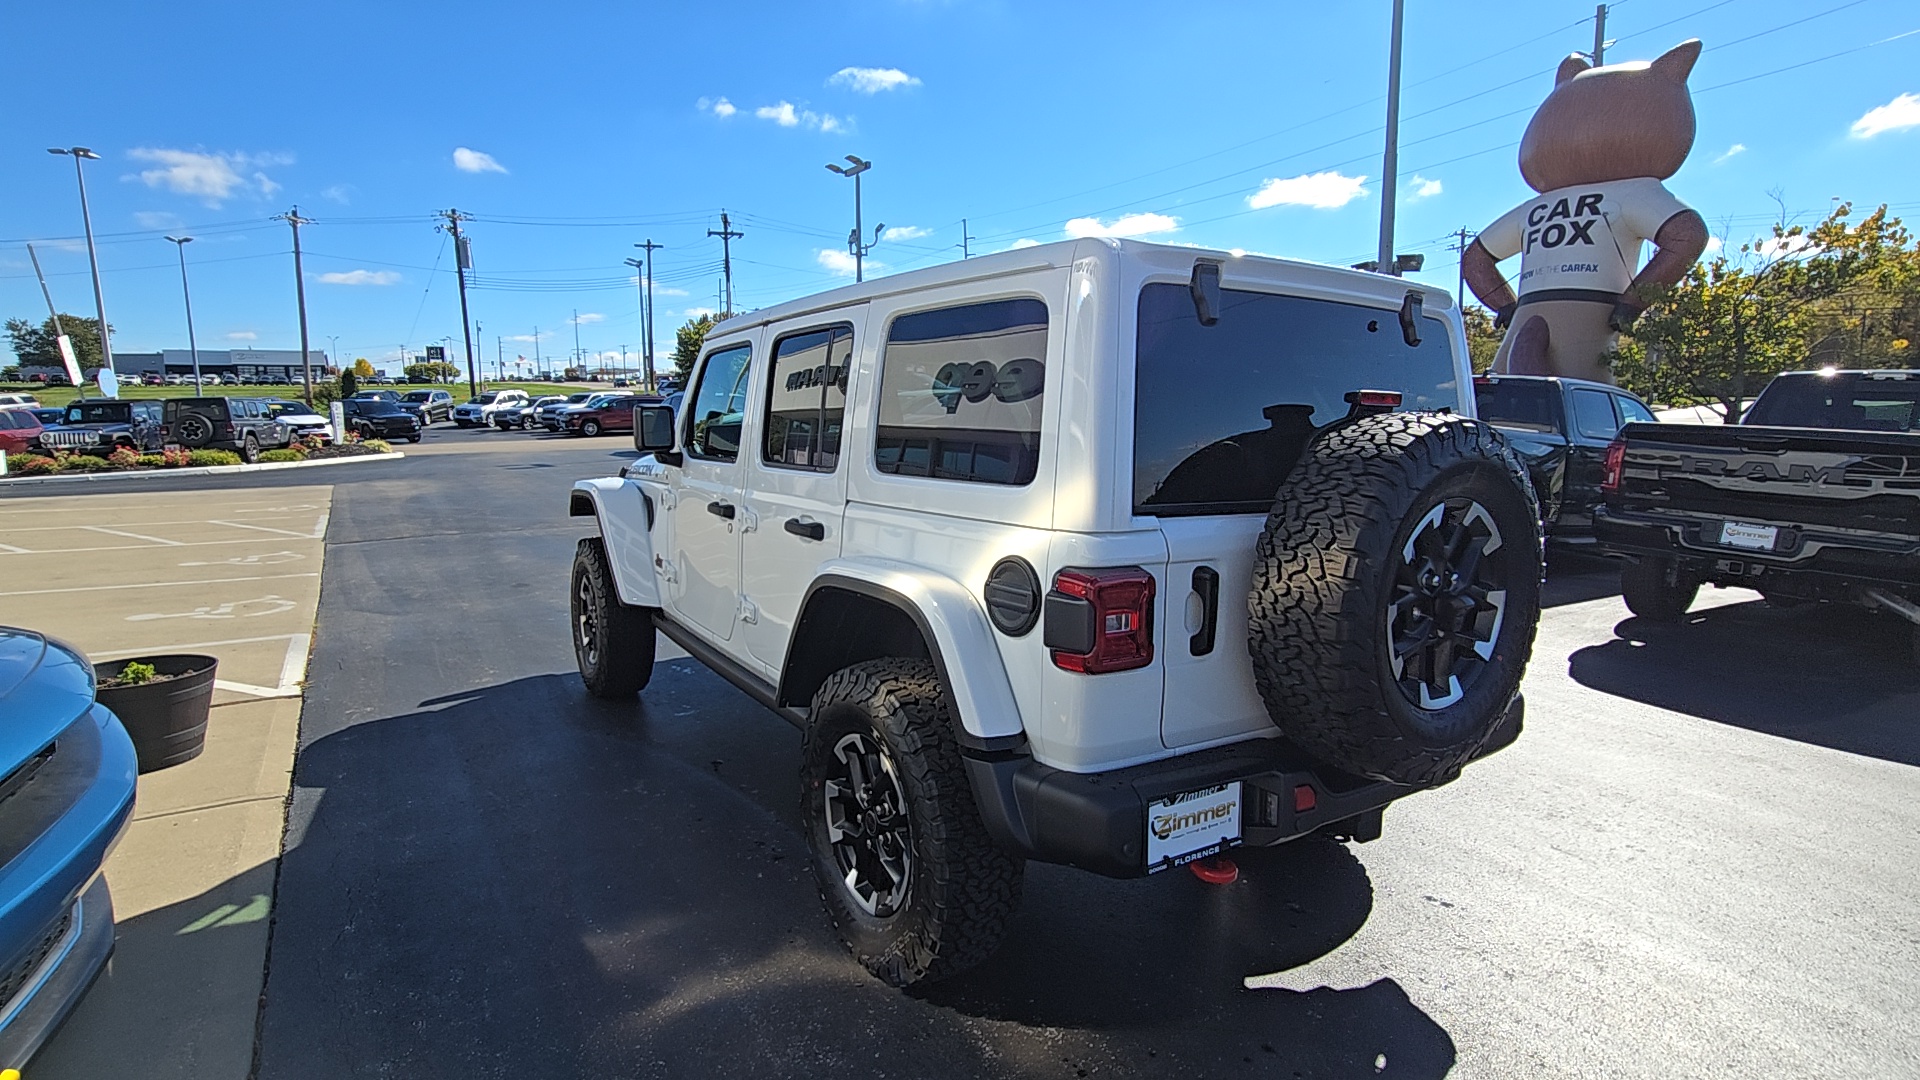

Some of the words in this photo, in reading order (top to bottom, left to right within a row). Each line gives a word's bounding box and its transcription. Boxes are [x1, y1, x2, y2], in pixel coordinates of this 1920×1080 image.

[1527, 193, 1604, 228] CAR
[1525, 219, 1598, 256] FOX
[1547, 264, 1560, 274] THE
[1561, 263, 1599, 273] CARFAX
[1680, 455, 1847, 485] RAM
[1174, 785, 1221, 806] Zimmer
[1151, 800, 1237, 840] Zimmer
[1174, 845, 1220, 867] FLORENCE
